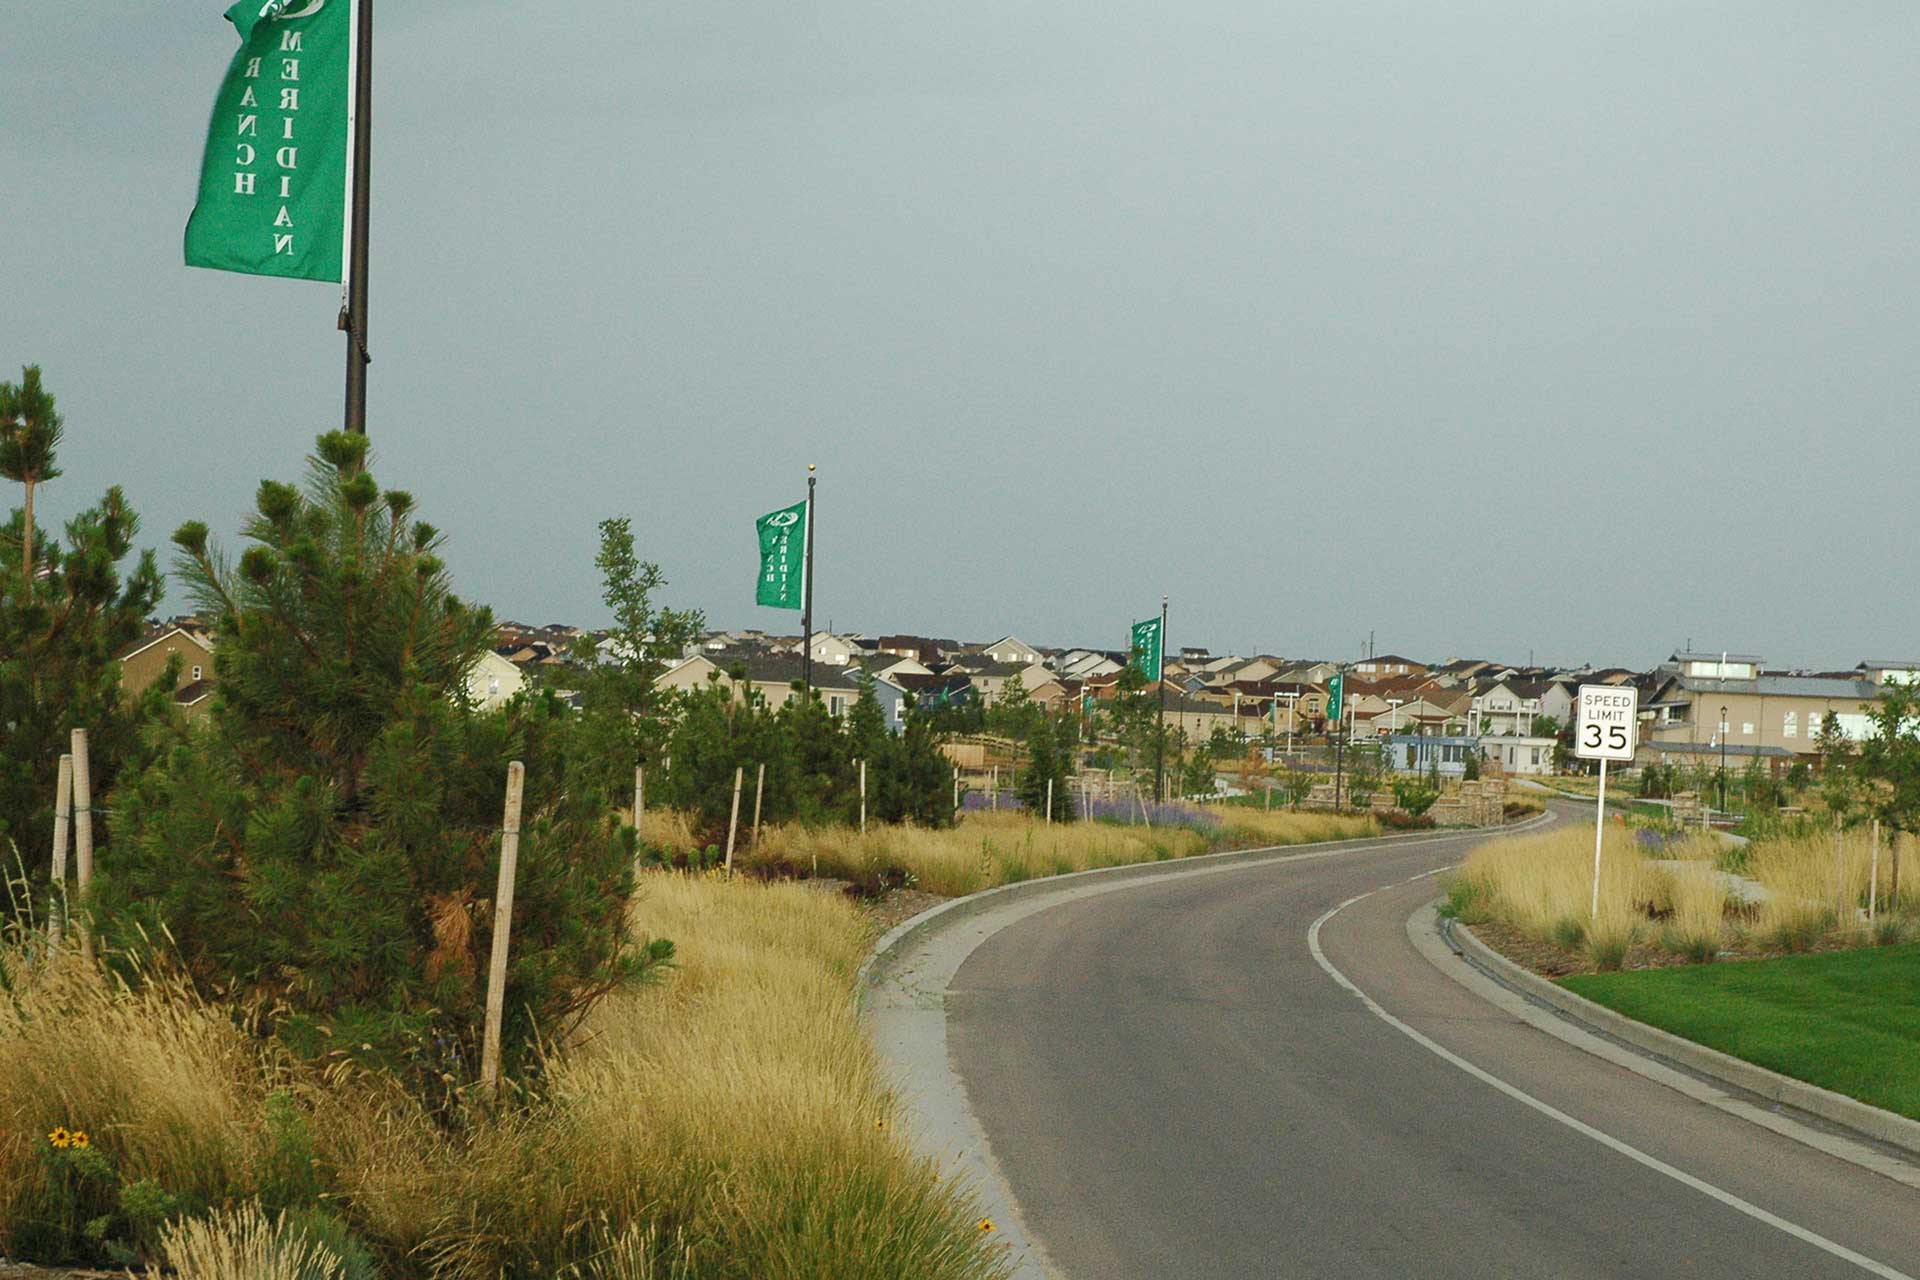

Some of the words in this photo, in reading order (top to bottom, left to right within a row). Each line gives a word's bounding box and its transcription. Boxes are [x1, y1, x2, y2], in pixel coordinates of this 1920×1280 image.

[1584, 694, 1631, 707] SPEED
[1588, 709, 1625, 721] LIMIT
[1584, 724, 1627, 750] 35
